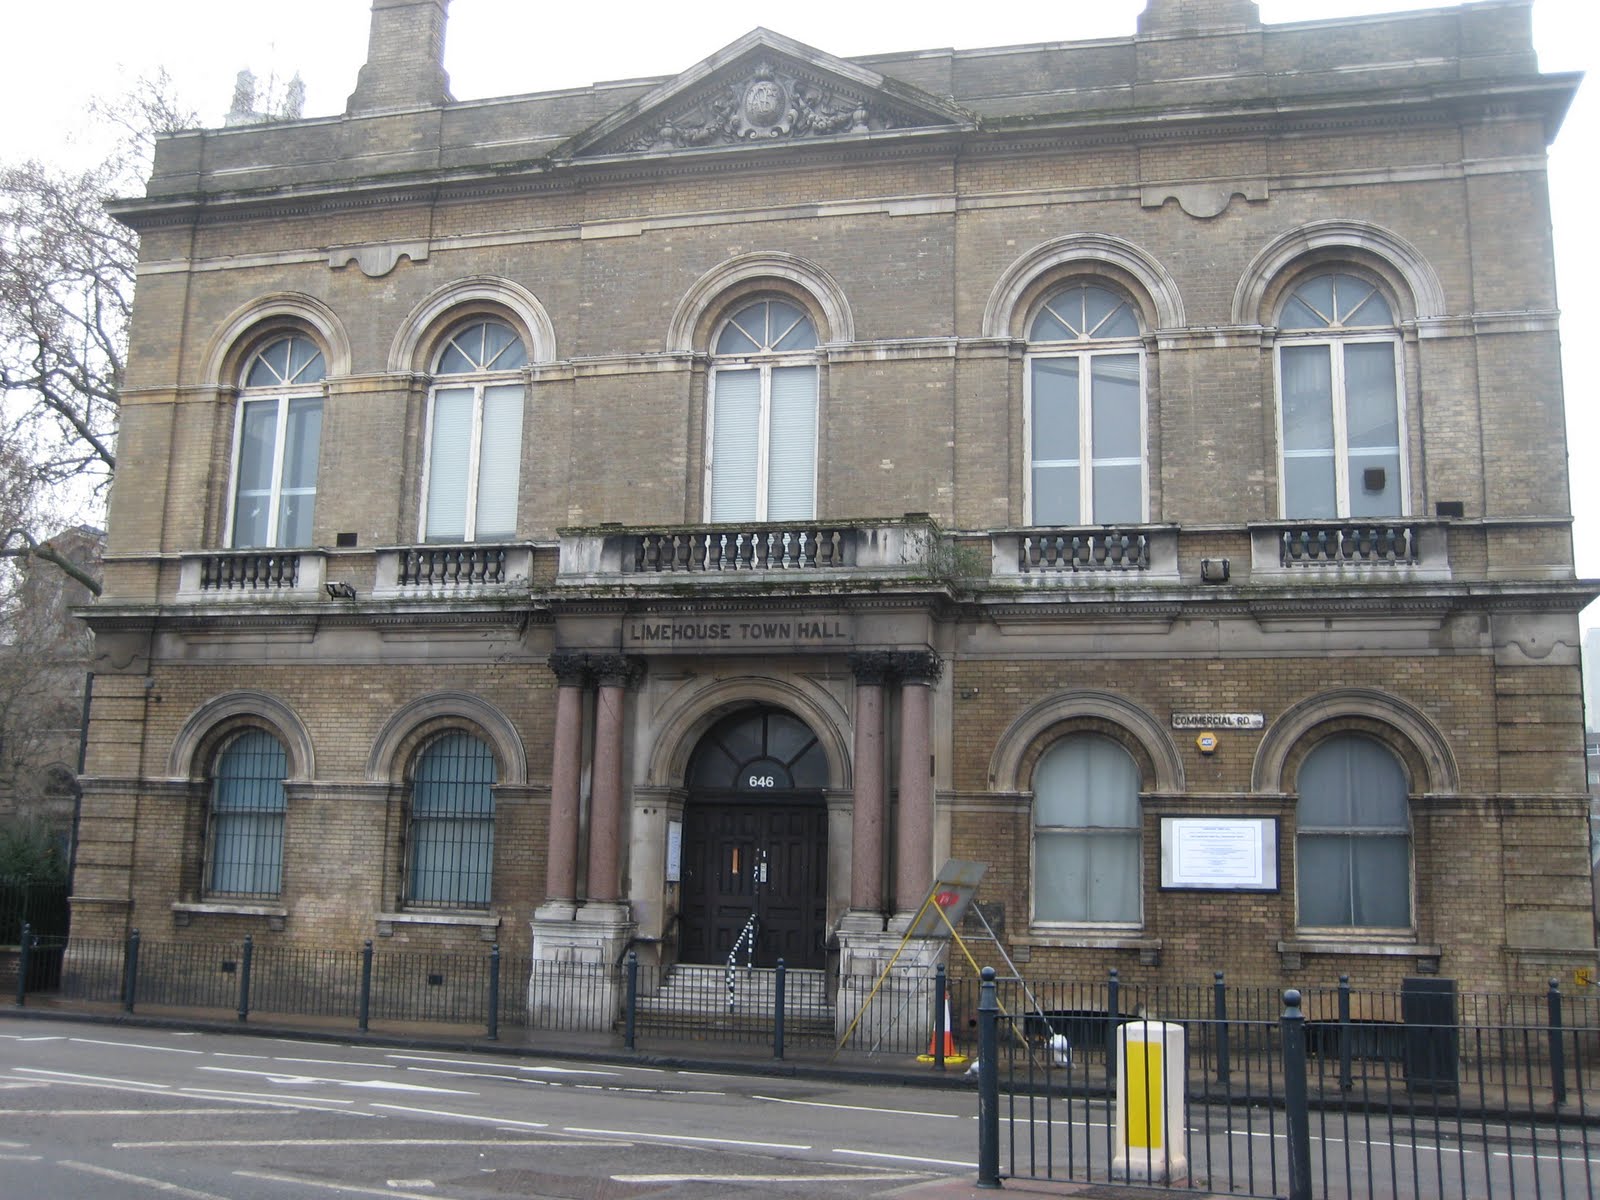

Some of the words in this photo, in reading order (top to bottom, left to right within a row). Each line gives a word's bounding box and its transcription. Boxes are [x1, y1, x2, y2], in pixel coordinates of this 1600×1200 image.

[630, 624, 731, 641] LIMEHOUSE
[739, 623, 791, 640] TOWN
[797, 622, 847, 639] HALL
[1174, 716, 1233, 726] COMMERCIAL
[749, 776, 774, 787] 646
